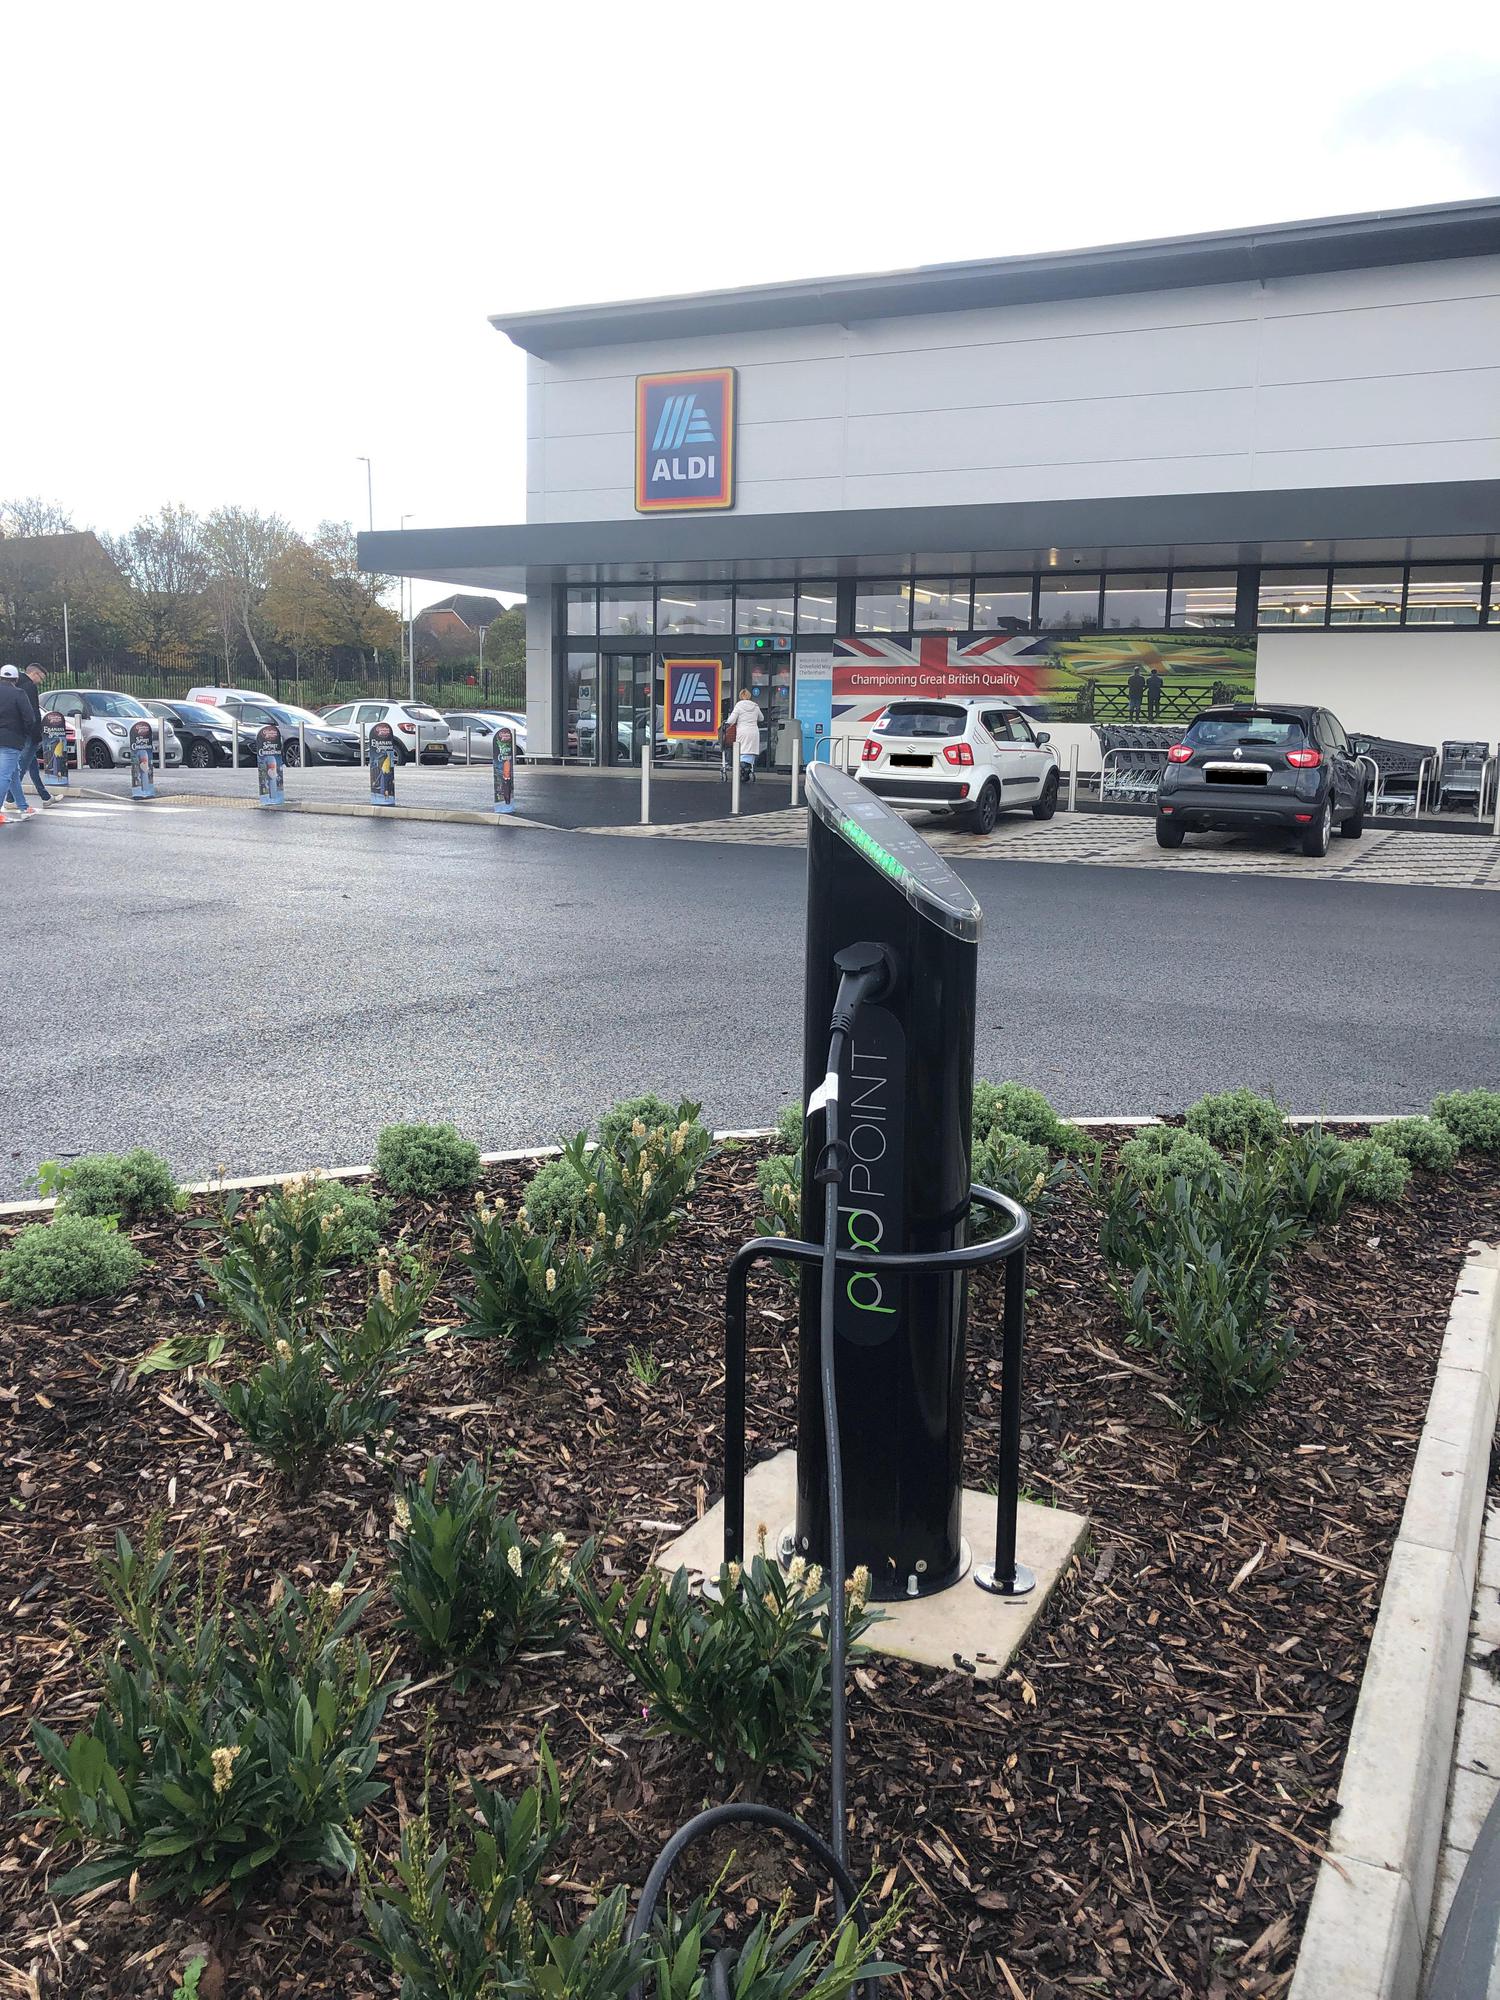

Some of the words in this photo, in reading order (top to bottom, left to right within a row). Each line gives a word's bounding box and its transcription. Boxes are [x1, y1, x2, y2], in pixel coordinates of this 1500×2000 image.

[652, 455, 715, 482] ALDI
[851, 673, 917, 687] Championing
[919, 674, 946, 685] Great
[948, 673, 980, 685] British
[982, 673, 1020, 687] Quality
[673, 708, 711, 723] ALDI
[850, 1040, 888, 1197] POINT
